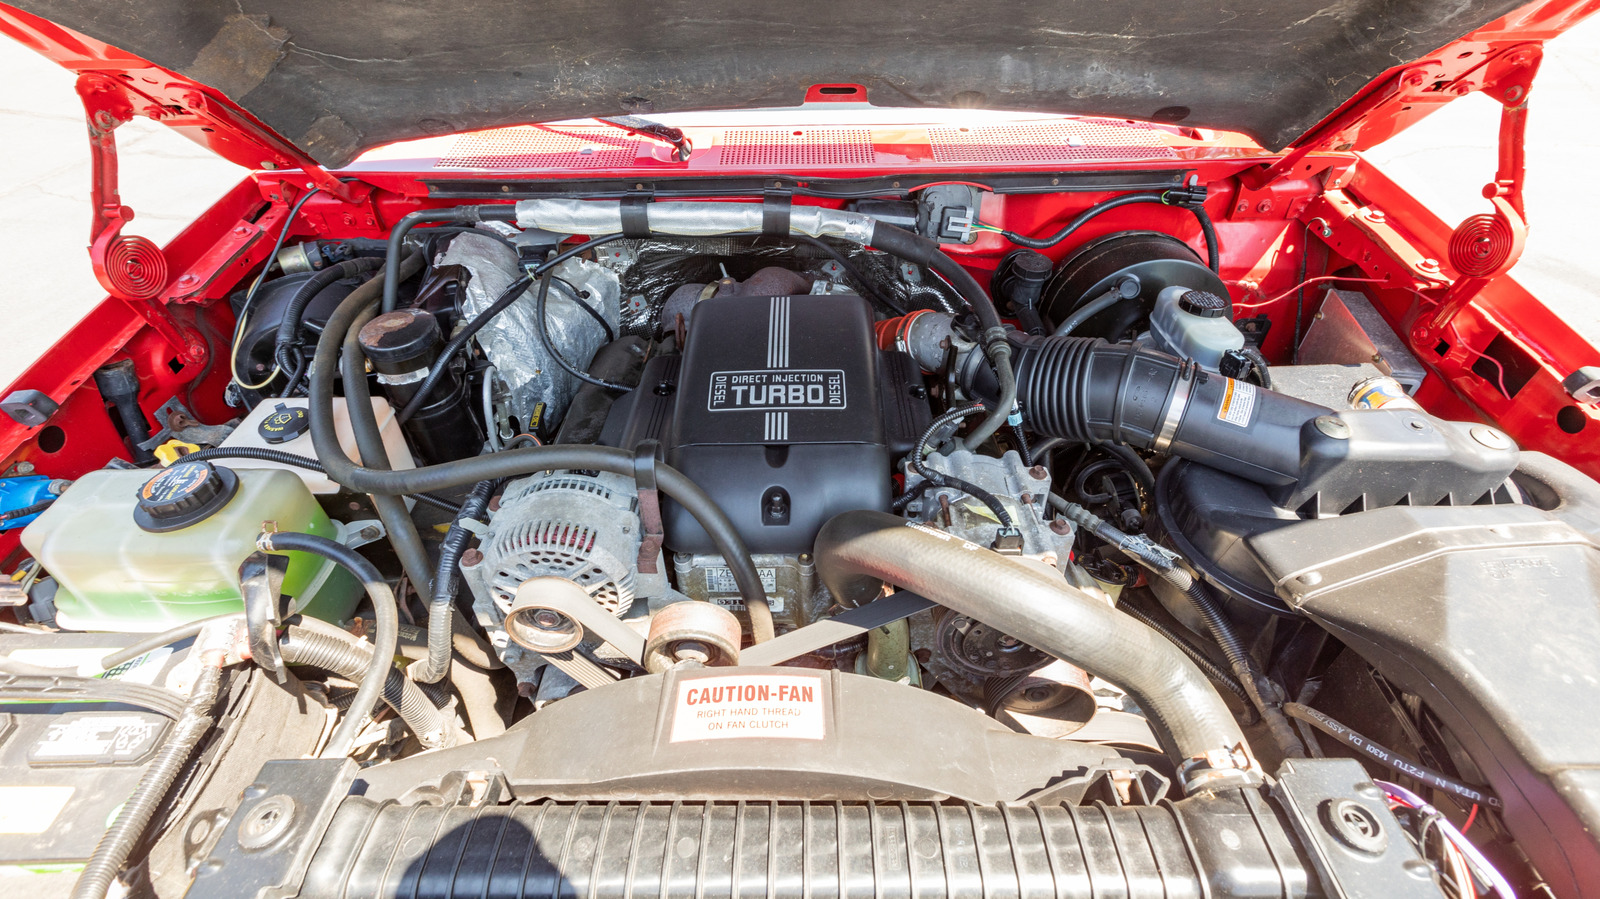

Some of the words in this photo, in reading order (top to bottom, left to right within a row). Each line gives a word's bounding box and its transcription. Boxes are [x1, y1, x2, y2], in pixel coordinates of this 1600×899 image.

[732, 374, 767, 384] DIRECT
[772, 374, 823, 383] INJECTION
[713, 375, 727, 406] DIESEL
[731, 384, 824, 405] TURBO
[829, 374, 841, 405] DIESEL
[686, 685, 813, 706] CAUTION-FAN
[697, 708, 727, 719] RIGHT
[730, 707, 758, 716] HAND
[763, 707, 801, 717] THREAD
[708, 722, 723, 731] ON
[727, 721, 746, 730] FAN
[749, 720, 789, 729] CLUTCH
[1323, 720, 1345, 734] ASSY
[1348, 733, 1363, 746] DA
[1365, 744, 1389, 761] 14301
[1393, 758, 1426, 779] F2TU
[1454, 784, 1481, 801] UTA
